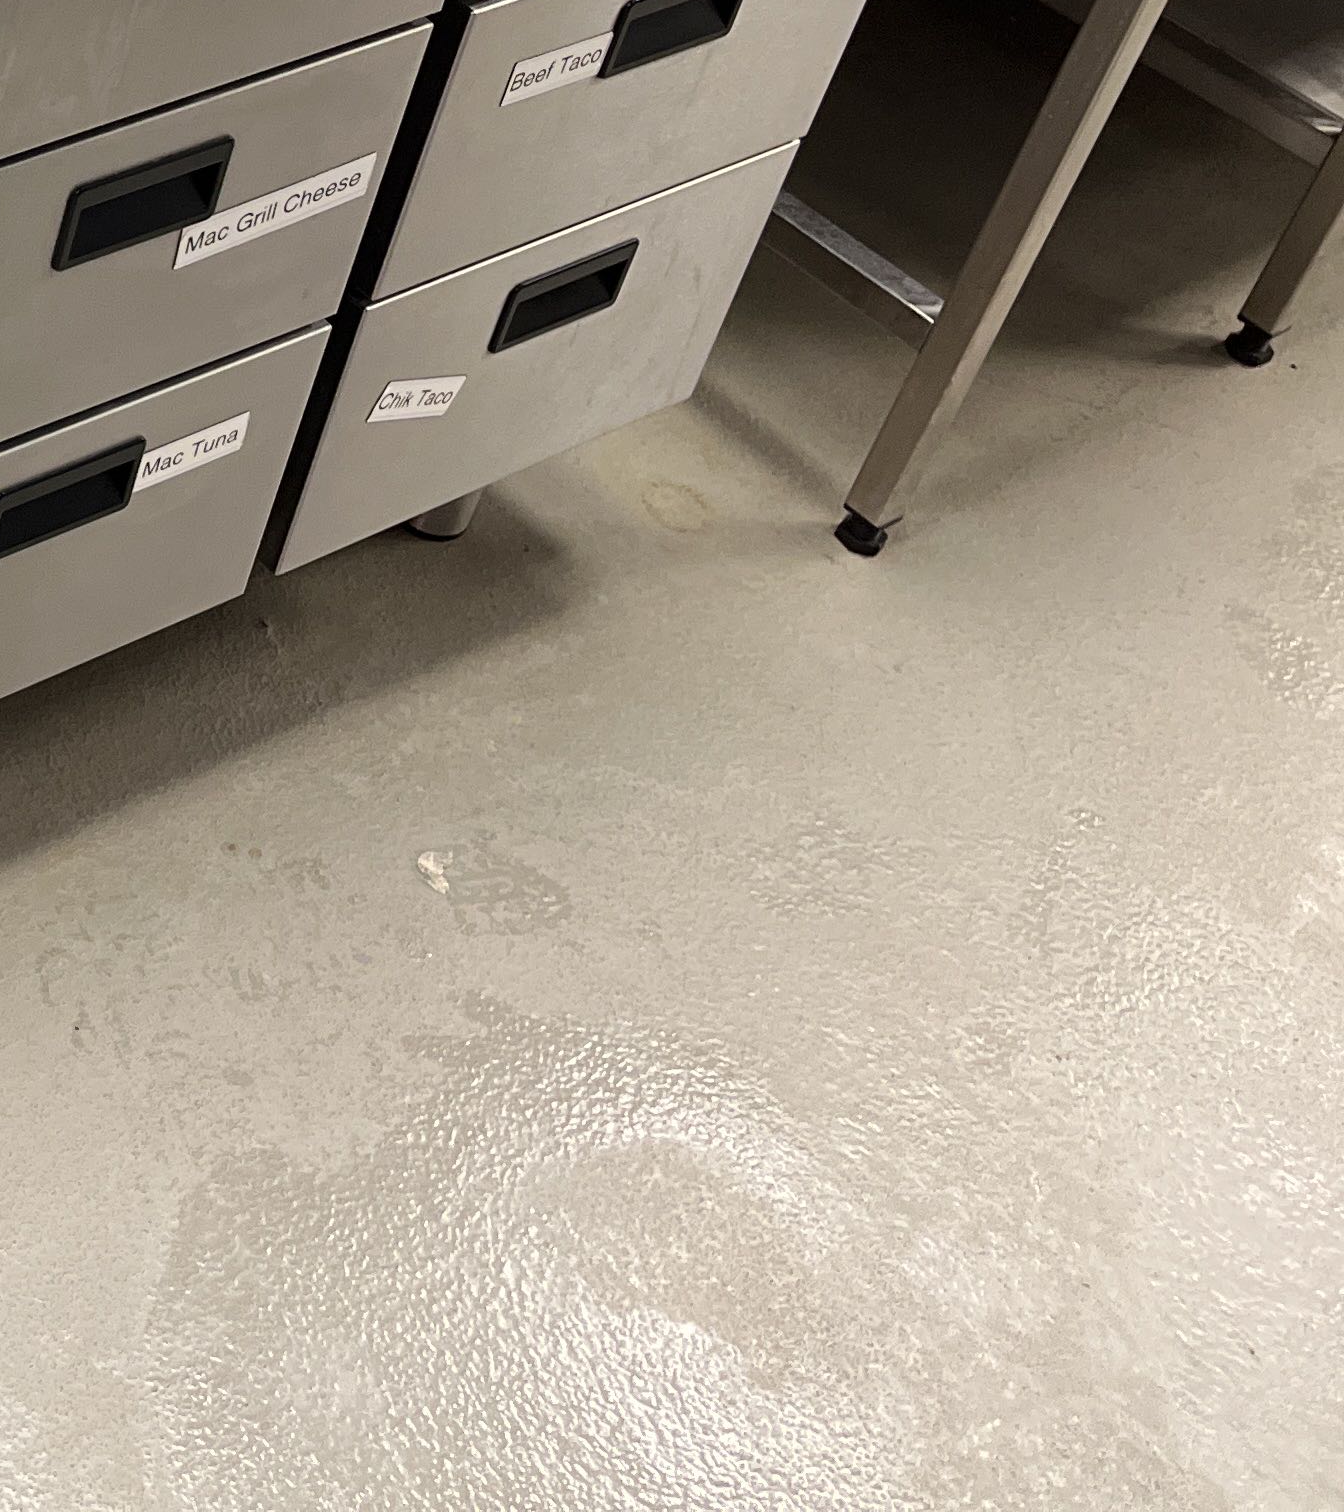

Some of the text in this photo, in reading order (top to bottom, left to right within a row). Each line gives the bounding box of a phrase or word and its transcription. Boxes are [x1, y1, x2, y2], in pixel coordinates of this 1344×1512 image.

[509, 48, 602, 92] Beef Taco
[184, 171, 362, 255] Mac Grill Cheese
[378, 389, 454, 410] Chik Taco
[141, 427, 239, 478] Mac Tuna
